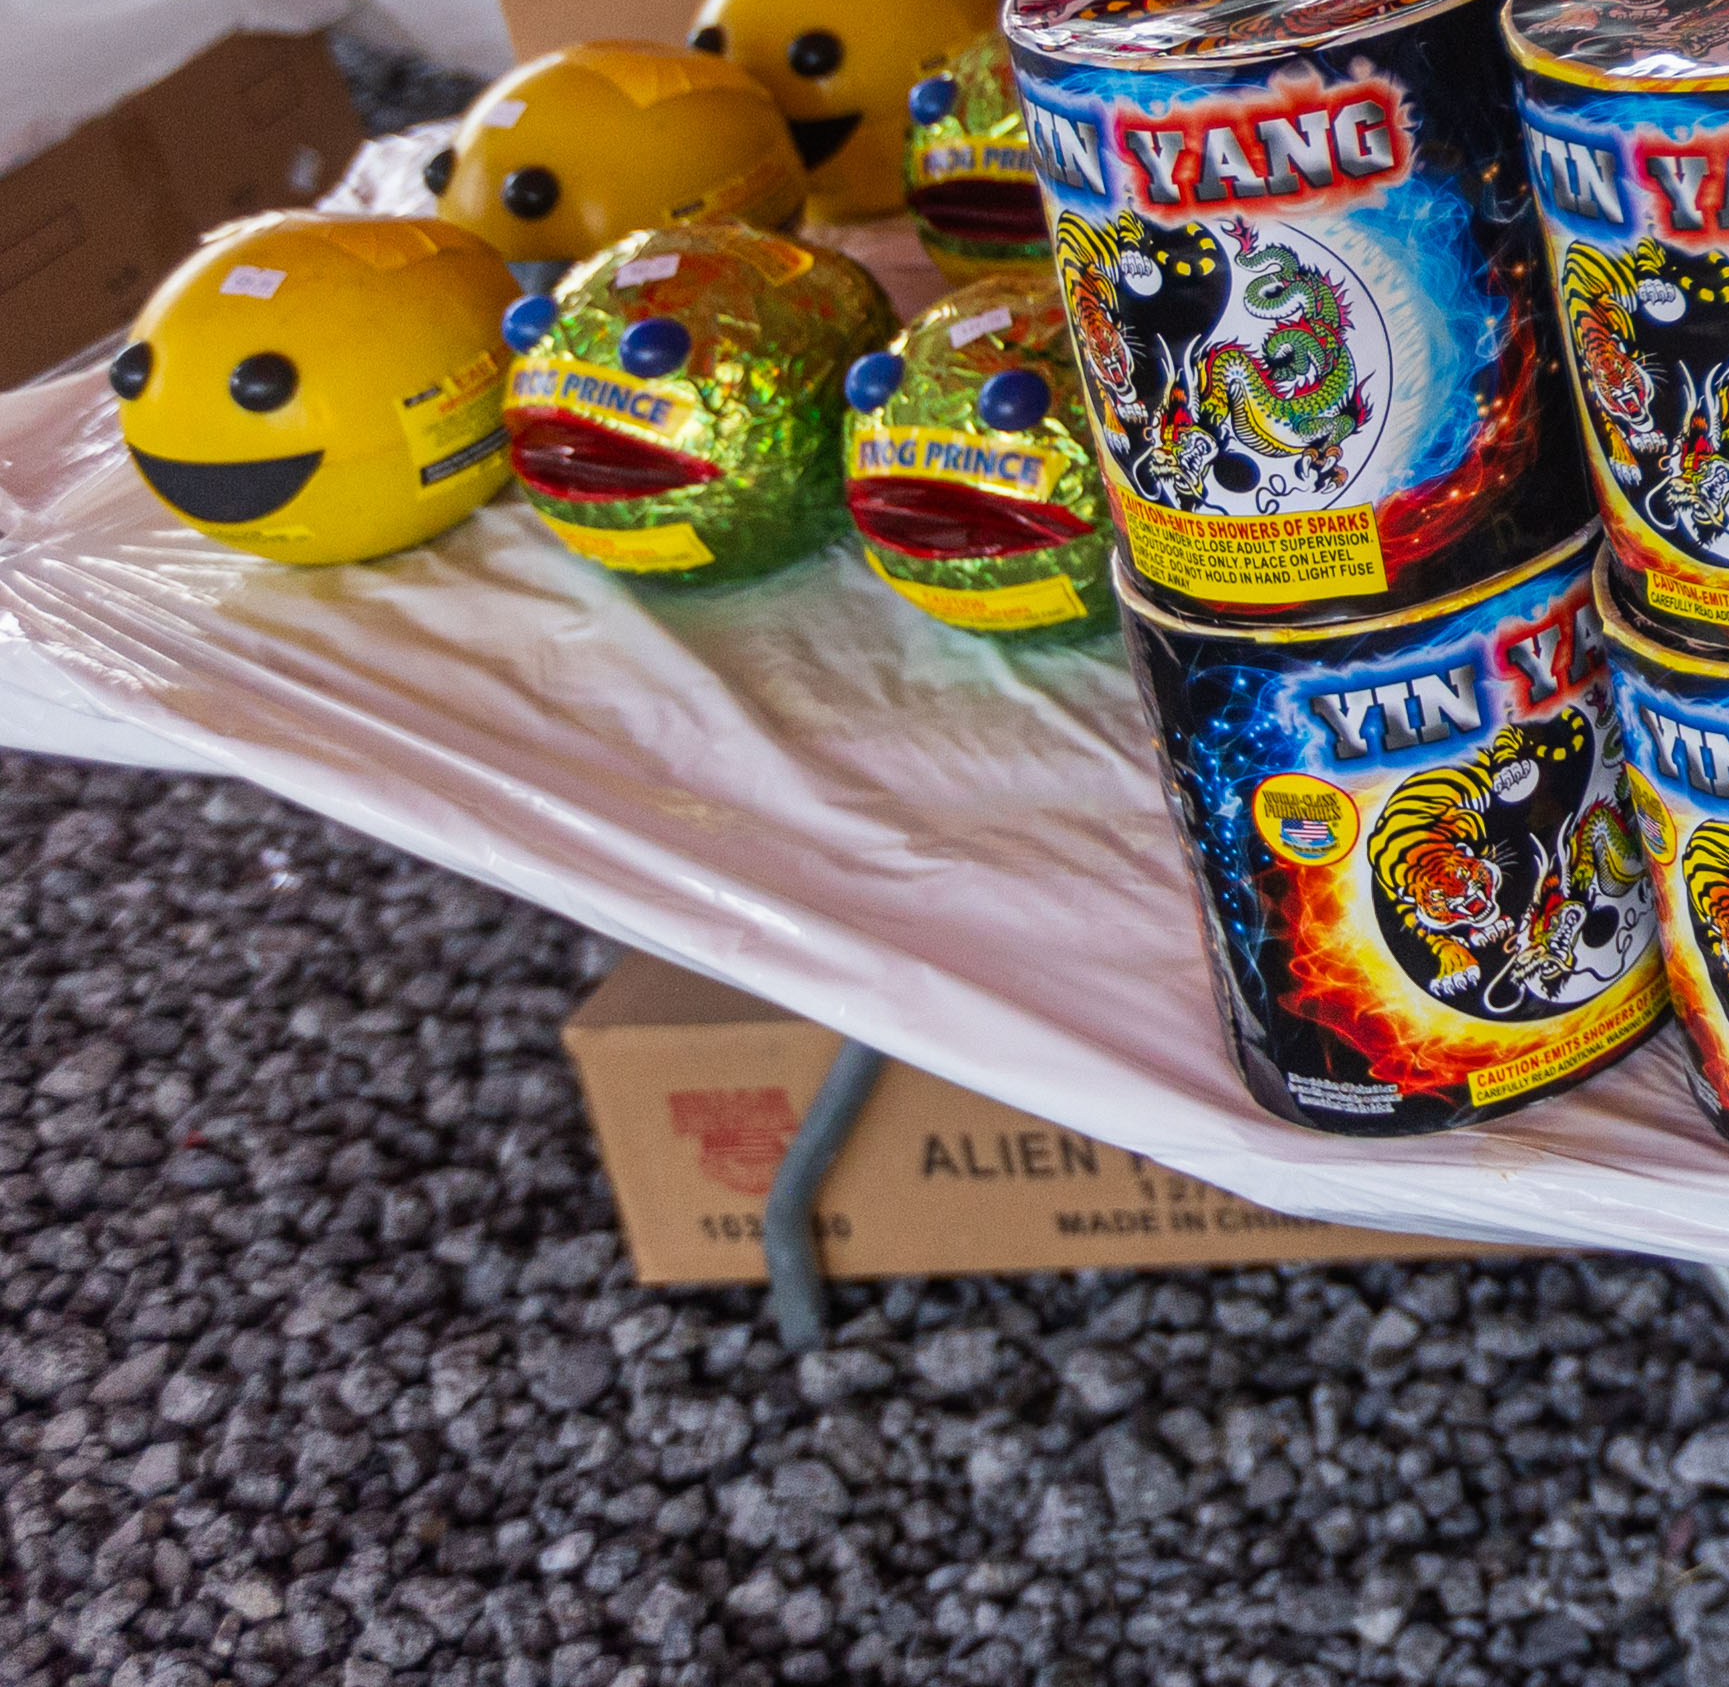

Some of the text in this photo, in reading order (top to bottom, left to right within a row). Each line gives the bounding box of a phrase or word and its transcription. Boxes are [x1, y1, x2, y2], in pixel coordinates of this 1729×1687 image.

[1124, 96, 1397, 203] YANG
[1529, 124, 1629, 226] YIN
[562, 373, 672, 425] PRINCE
[924, 443, 1045, 485] PRINCE
[1194, 532, 1374, 554] CLOSE ADULT SUPERVISION.
[1209, 511, 1369, 540] SHOWERS OF SPARKS
[1206, 562, 1375, 584] HOLD IN LIGHT FUSE
[1245, 548, 1355, 569] PLACE ON LEVEL
[1310, 603, 1606, 760] YIN YA
[1477, 1037, 1580, 1087] CAUTION-EMITS
[921, 1131, 1097, 1180] ALIEN
[1056, 1211, 1159, 1233] MADE
[1169, 1211, 1207, 1232] IN
